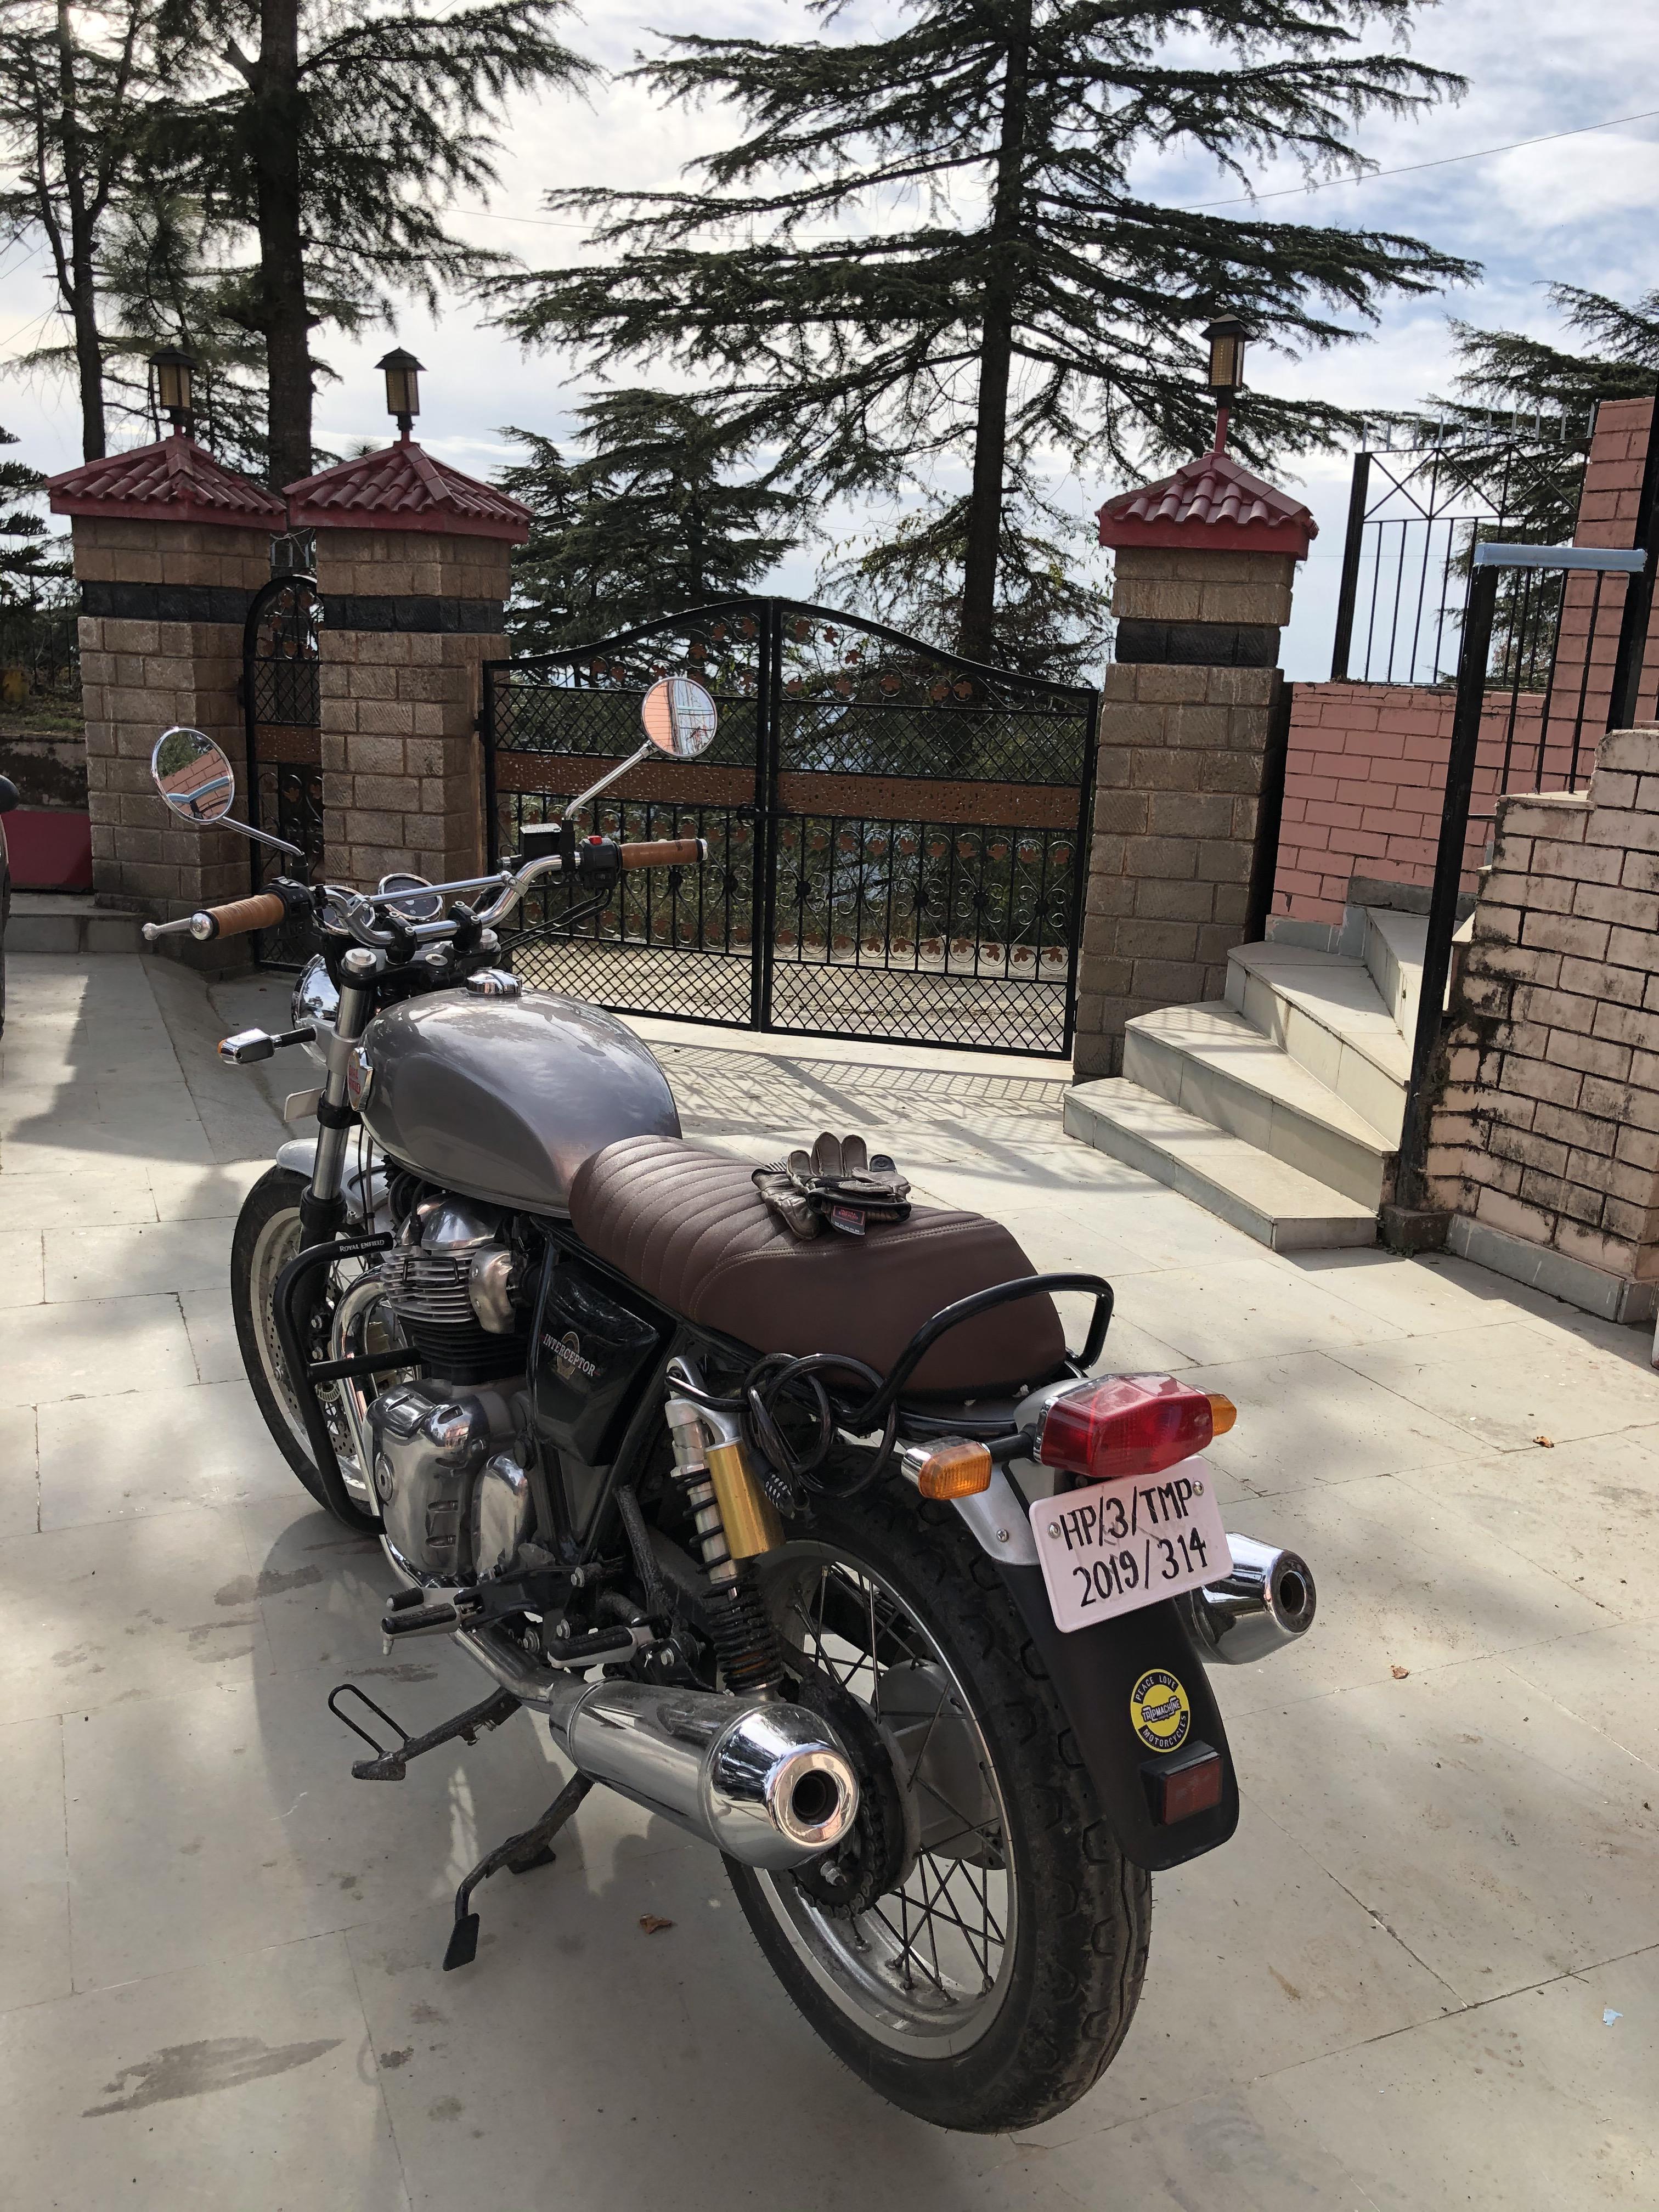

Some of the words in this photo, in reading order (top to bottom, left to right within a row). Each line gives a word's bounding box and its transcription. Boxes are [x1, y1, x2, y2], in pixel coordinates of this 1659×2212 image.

[339, 1244, 359, 1252] ROYAL
[360, 1239, 385, 1249] ENFIELD
[543, 1333, 596, 1377] INTERCEPTOR
[1135, 1677, 1154, 1701] PEACE
[1159, 1675, 1176, 1689] LOVE
[1143, 1696, 1181, 1722] TRIPMACHINE
[1143, 1715, 1186, 1747] MOTORCYCLES
